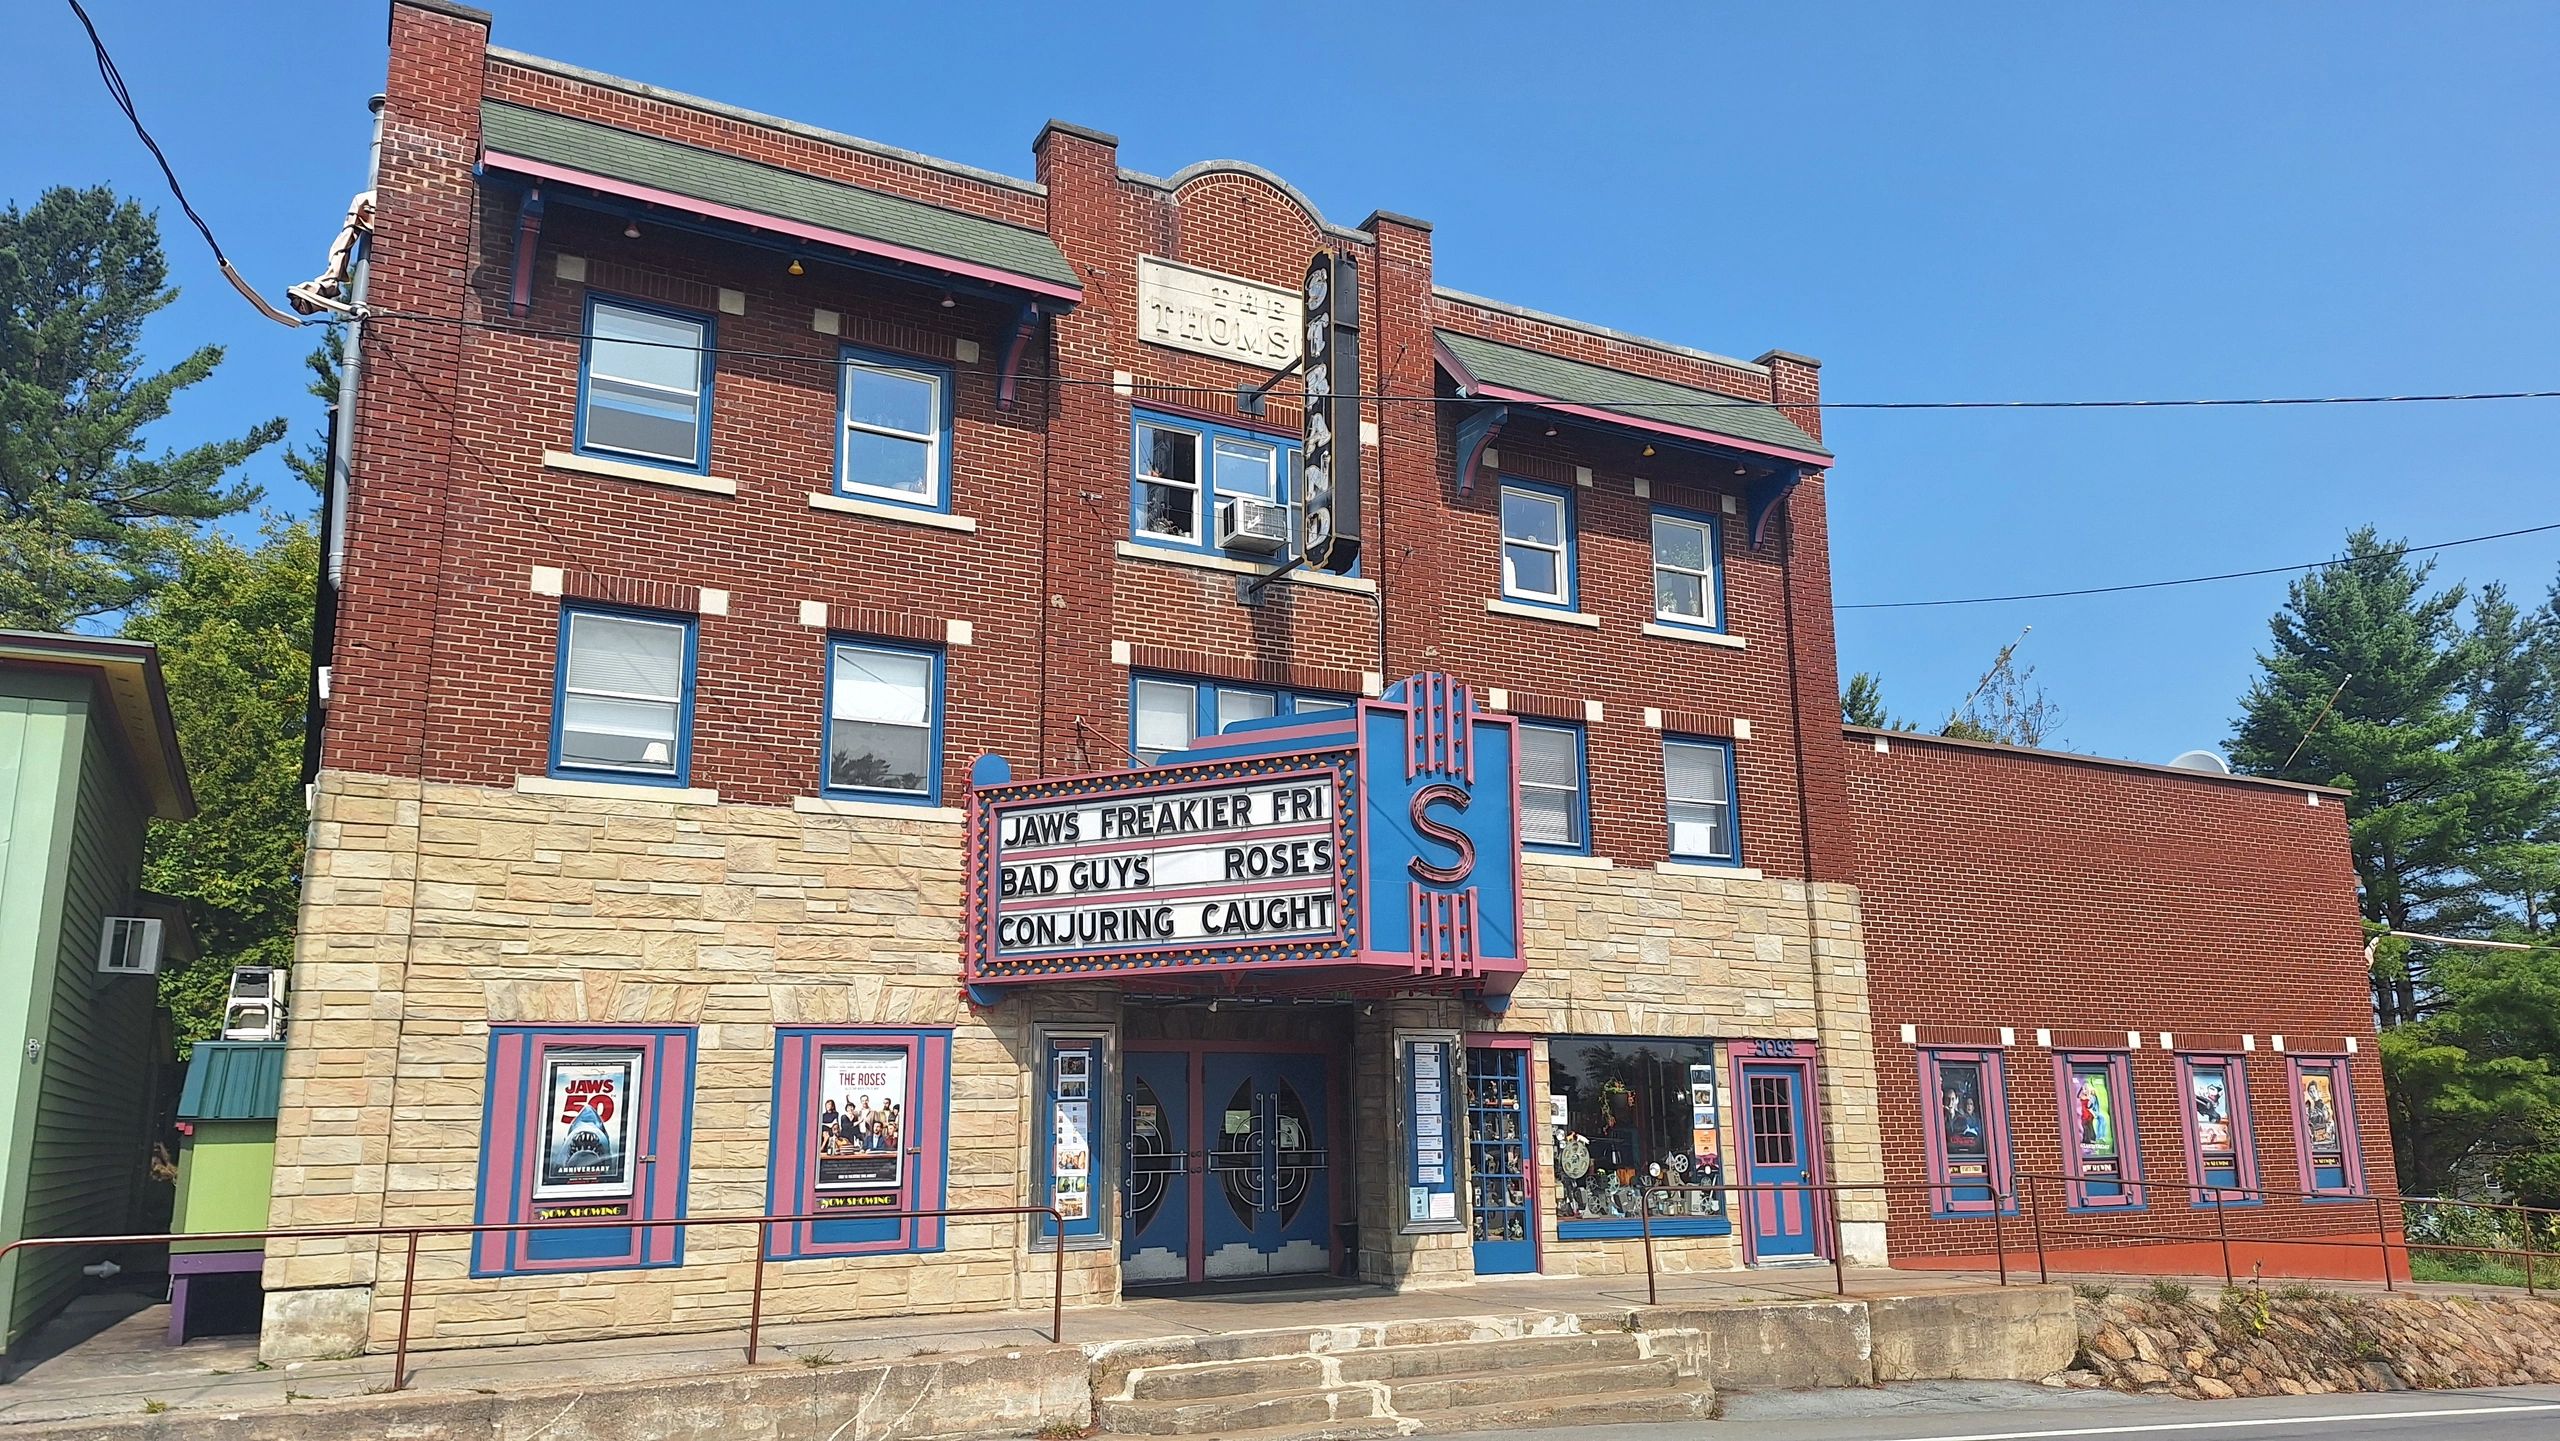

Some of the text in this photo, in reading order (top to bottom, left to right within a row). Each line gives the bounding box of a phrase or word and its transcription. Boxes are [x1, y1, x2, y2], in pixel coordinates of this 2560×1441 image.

[1211, 284, 1286, 322] THE
[1151, 297, 1302, 360] THOMS
[1304, 268, 1332, 550] STRAND
[1004, 787, 1323, 846] JAWS FREAKIER FRI
[1408, 784, 1476, 886] S
[1001, 840, 1332, 897] BAD GUYS ROSES
[999, 895, 1332, 947] CONJURING CAUGHT
[565, 1079, 614, 1094] JAWS
[840, 1072, 886, 1086] THE ROSES
[561, 1094, 615, 1124] 50
[540, 1206, 621, 1220] NOW SHOWING
[820, 1195, 892, 1209] NOW SHOWING
